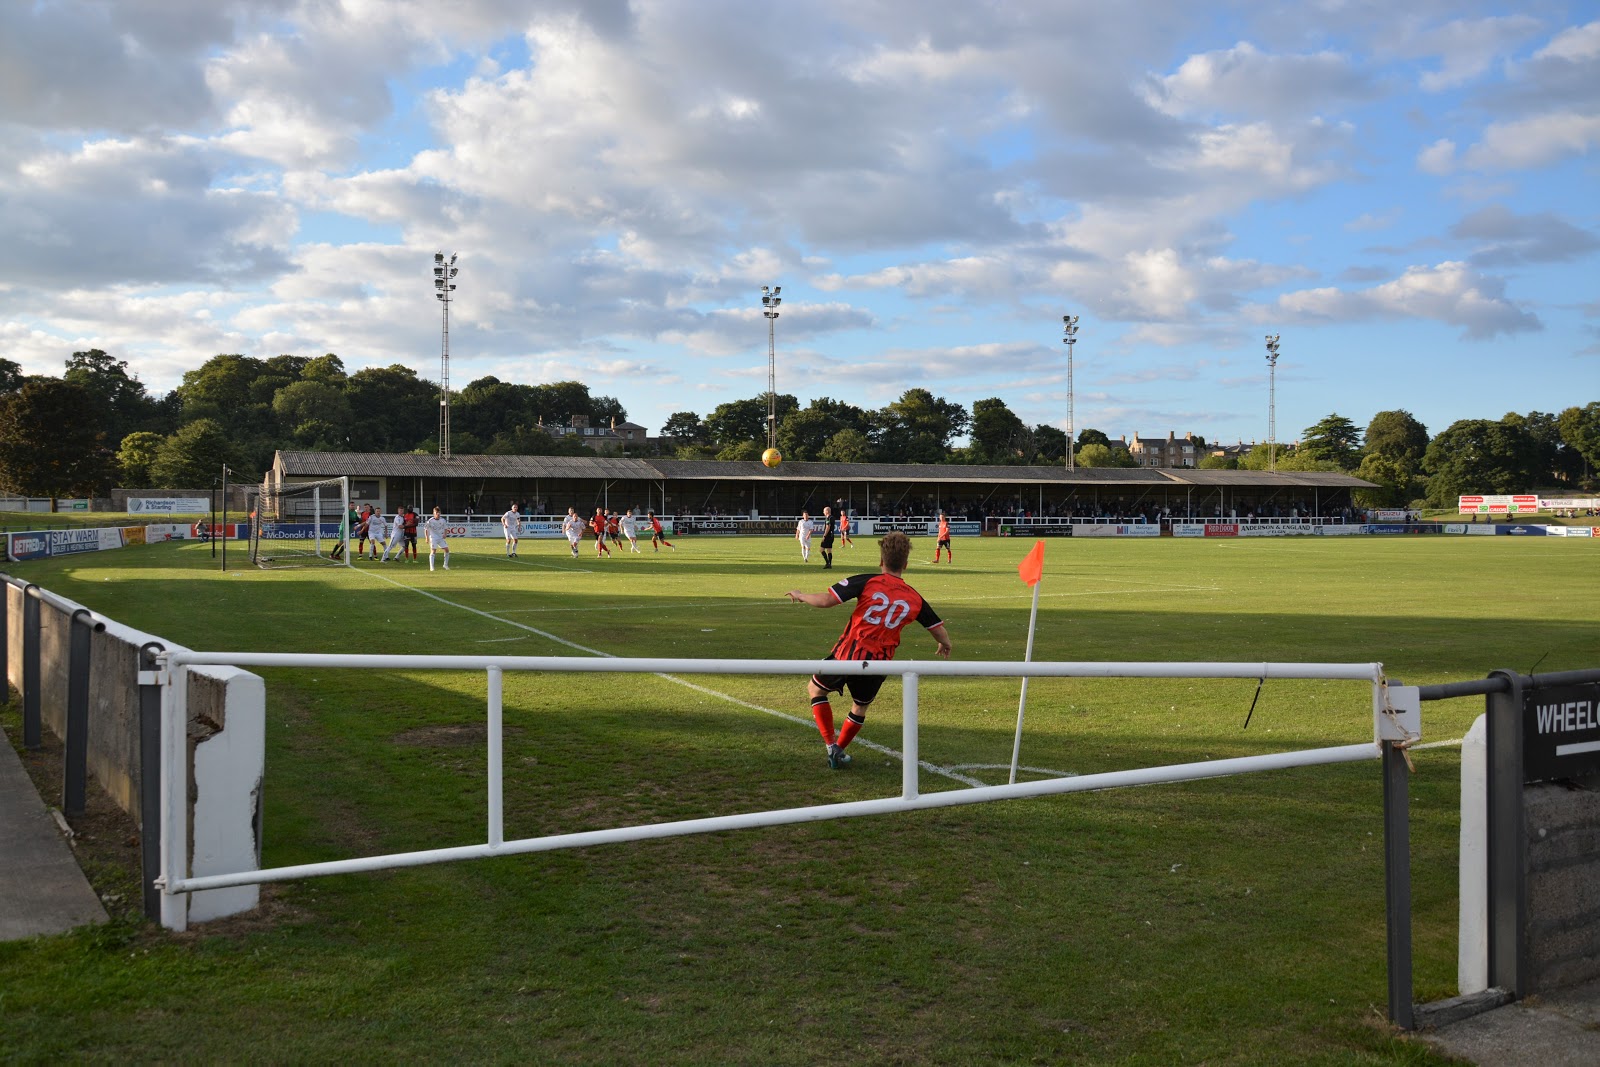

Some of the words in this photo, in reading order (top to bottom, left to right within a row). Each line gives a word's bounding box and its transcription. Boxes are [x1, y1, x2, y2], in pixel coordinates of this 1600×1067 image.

[52, 531, 74, 544] STAY
[75, 530, 98, 542] WARM
[863, 592, 910, 629] 20
